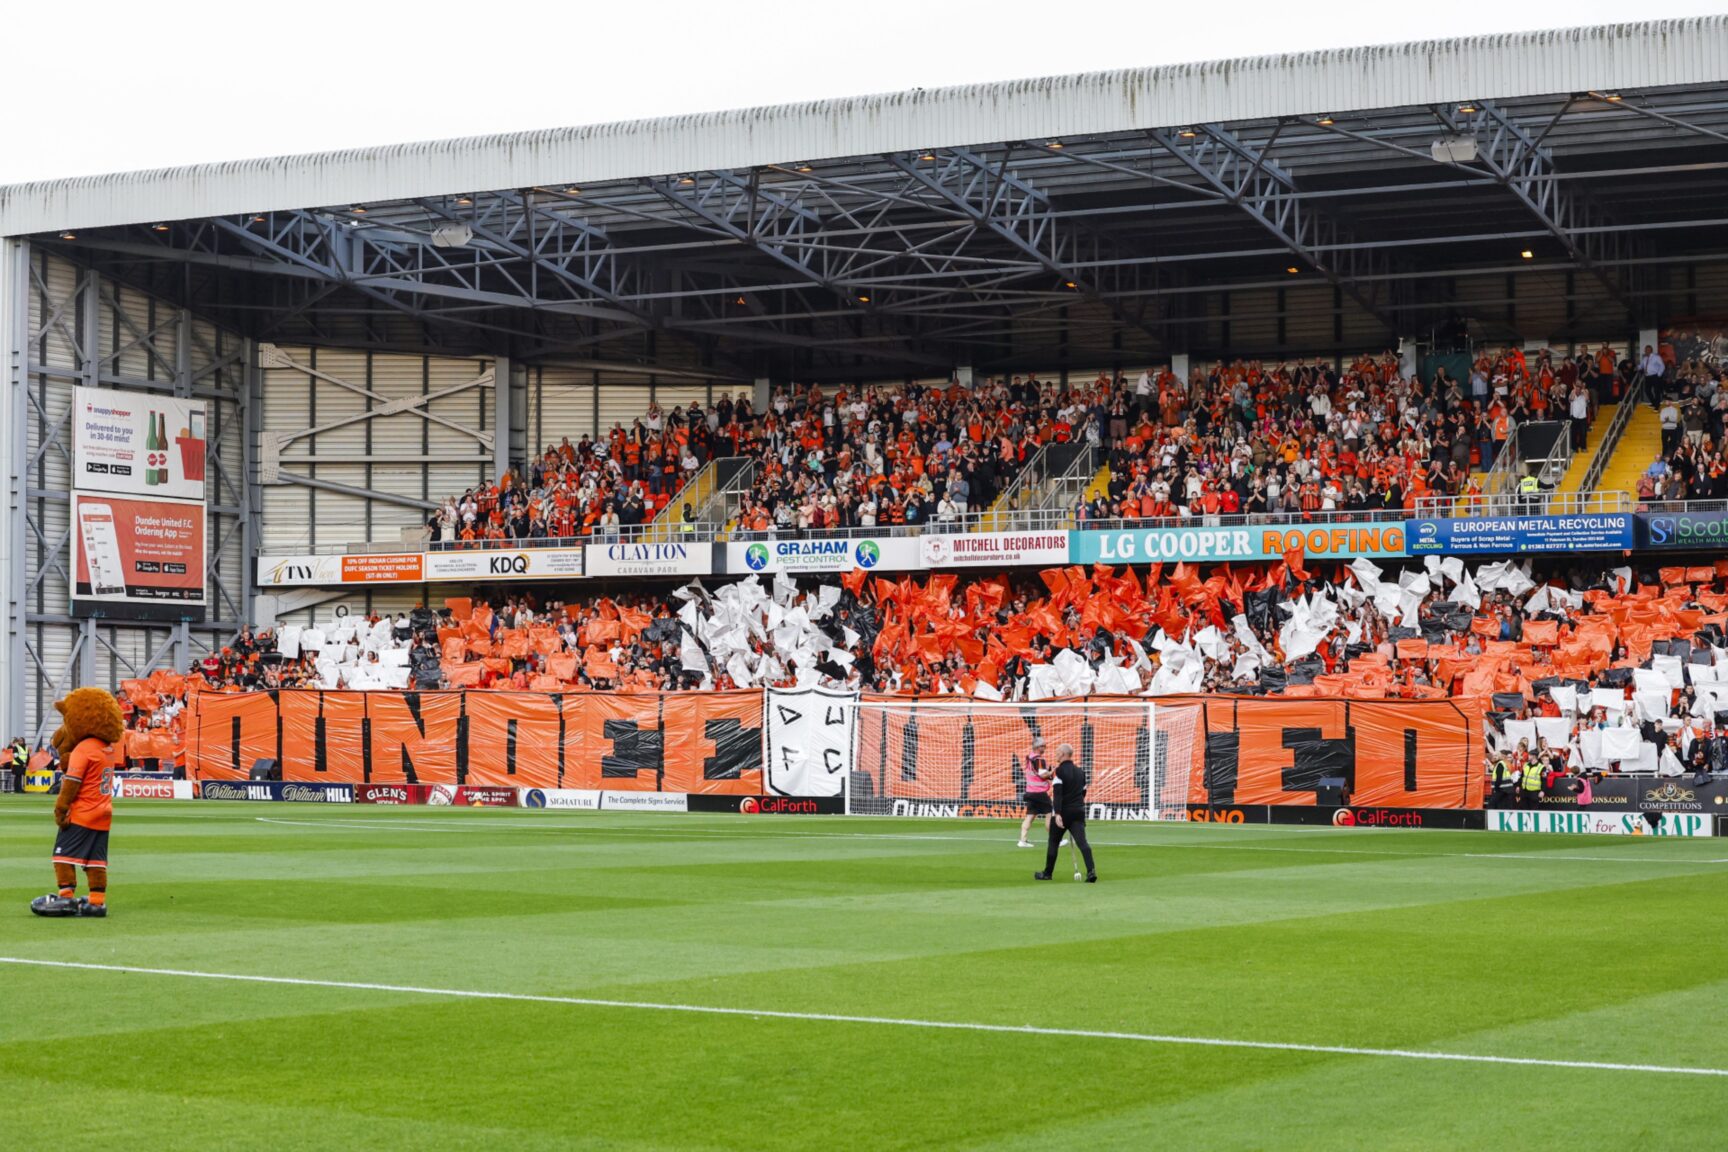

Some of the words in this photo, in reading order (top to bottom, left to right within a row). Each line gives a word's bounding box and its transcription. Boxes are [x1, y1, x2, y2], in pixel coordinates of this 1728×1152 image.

[86, 422, 114, 433] Delivered
[115, 425, 121, 433] to
[122, 427, 133, 436] you
[90, 432, 96, 440] in
[97, 432, 113, 441] 30-60
[114, 434, 130, 443] mins!
[135, 515, 160, 526] Dundee
[161, 517, 182, 527] United
[183, 519, 193, 528] F.C.
[1453, 521, 1516, 533] EUROPEAN
[1518, 519, 1556, 531] METAL
[1559, 517, 1625, 530] RECYCLING
[135, 526, 164, 538] Ordering
[164, 528, 177, 539] App
[777, 541, 848, 556] GRAHAM
[953, 538, 1000, 552] MITCHELL
[1003, 535, 1066, 551] DECORATORS
[1099, 533, 1136, 559] LG
[1144, 530, 1253, 559] COOPER
[1262, 527, 1404, 554] ROOFING
[608, 544, 687, 561] CLAYTON
[776, 555, 801, 564] PEST
[803, 554, 848, 564] CONTROL
[953, 553, 1021, 562] mitchelldecorators.co.uk
[490, 555, 527, 574] KDQ
[617, 566, 654, 574] CARAVAN
[335, 605, 348, 618] Q
[197, 690, 764, 797] DUNDEE
[125, 783, 172, 798] sports
[205, 783, 248, 801] William
[248, 785, 273, 800] HILL
[282, 784, 327, 802] William
[326, 787, 351, 803] HILL
[366, 787, 408, 801] GLEN'S
[550, 797, 593, 807] SIGNATURE
[608, 796, 619, 804] The
[619, 796, 646, 806] Complete
[648, 796, 663, 806] Signs
[664, 797, 685, 806] Service
[761, 797, 817, 813] CalForth
[1639, 802, 1703, 810] COMPETITIONS
[958, 804, 1028, 819] CASIN
[1357, 809, 1422, 825] CalForth
[1499, 811, 1592, 835] KELBIE
[1596, 819, 1616, 833] for
[1622, 812, 1702, 837] SRAP
